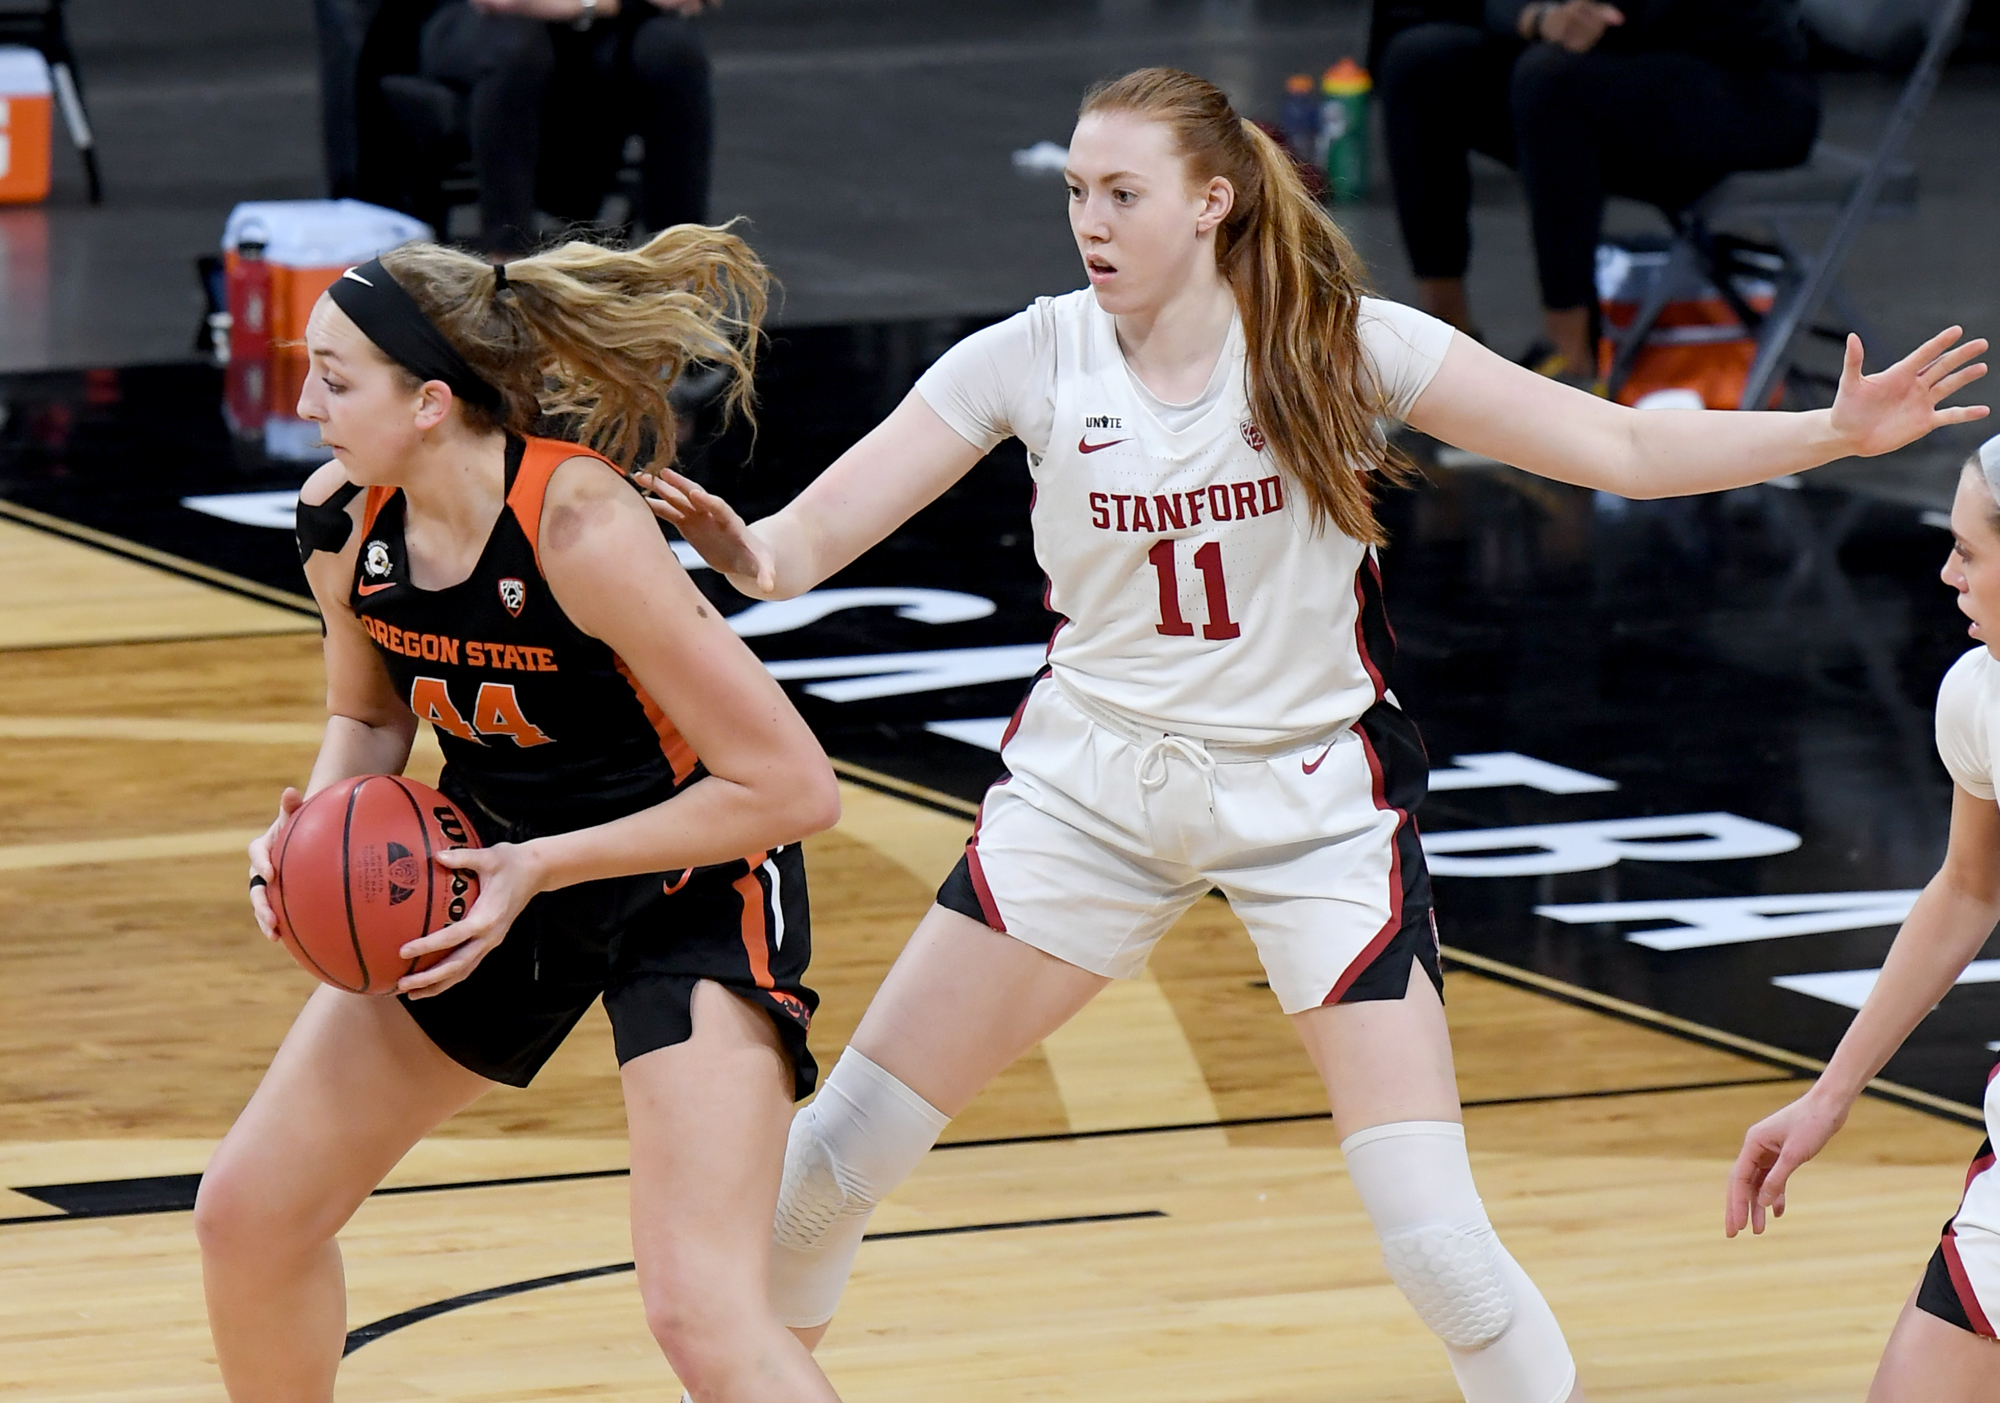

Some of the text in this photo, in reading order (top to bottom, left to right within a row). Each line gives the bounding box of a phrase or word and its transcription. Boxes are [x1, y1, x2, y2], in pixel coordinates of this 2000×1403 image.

[1089, 475, 1284, 532] STANFORD
[500, 580, 523, 602] PAC
[506, 594, 520, 608] 12
[1148, 539, 1241, 640] 11
[361, 614, 559, 672] OREGON STATE
[410, 676, 557, 748] 44
